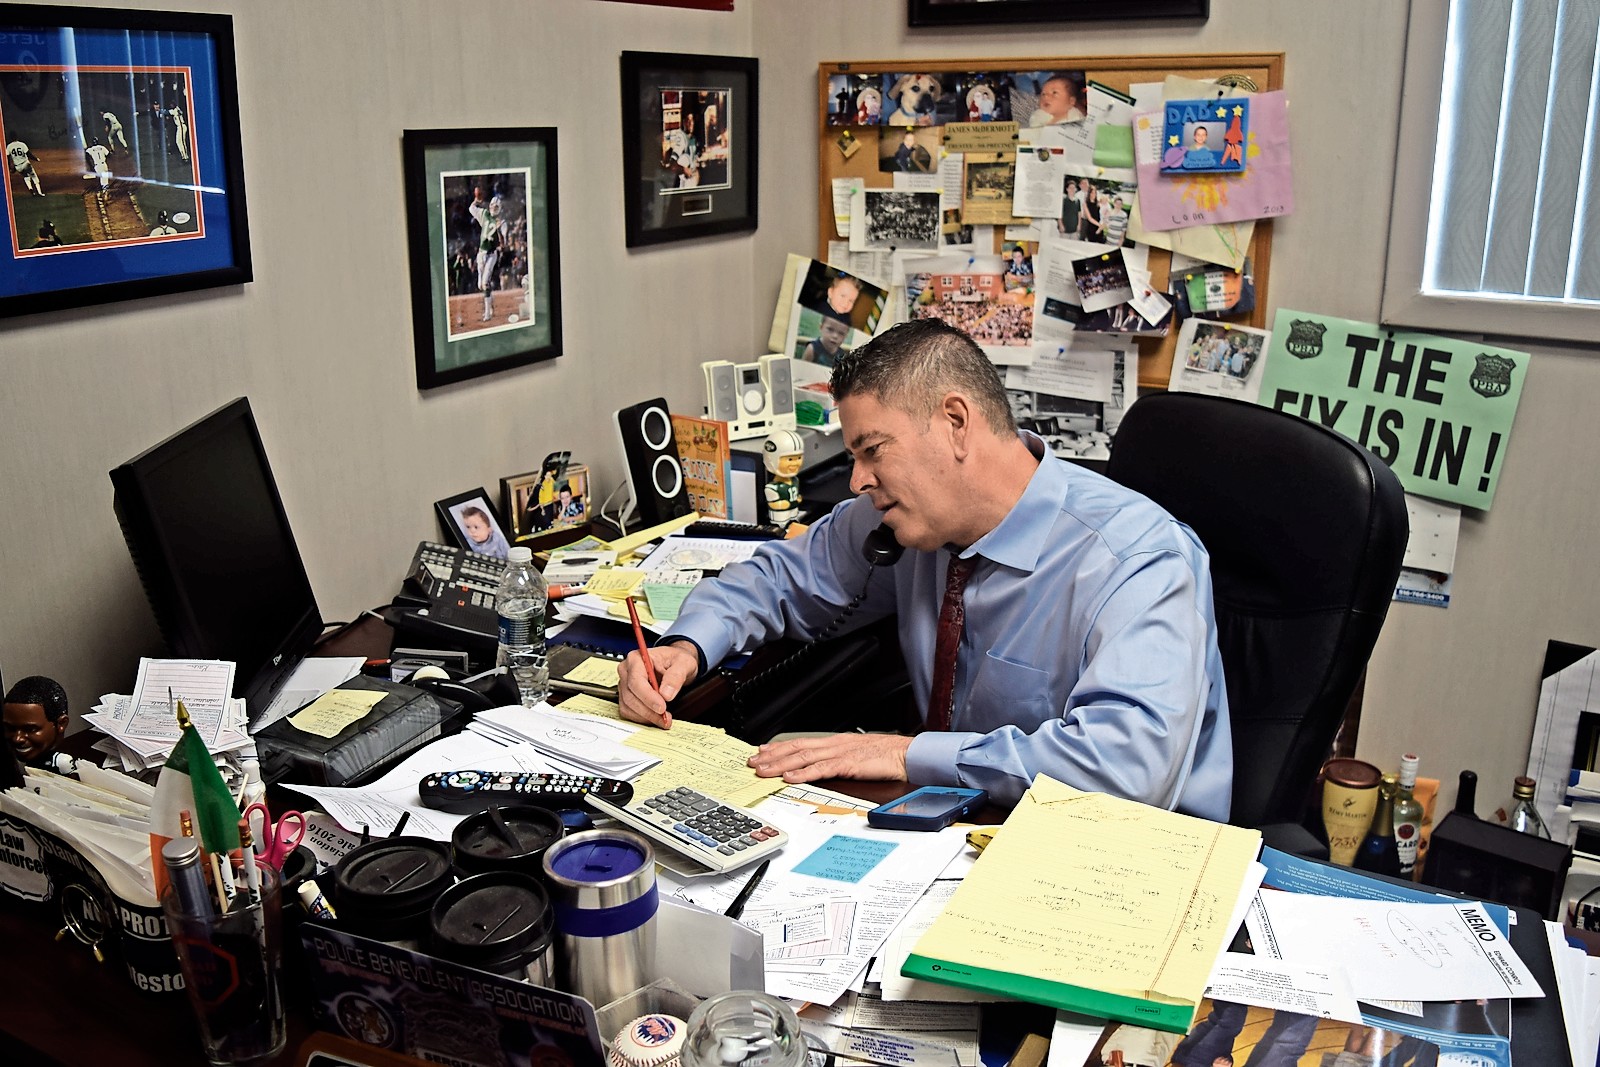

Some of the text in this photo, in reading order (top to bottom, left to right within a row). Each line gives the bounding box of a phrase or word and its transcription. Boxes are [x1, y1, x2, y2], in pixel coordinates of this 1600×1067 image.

[1167, 104, 1211, 125] DAD
[947, 124, 1016, 134] JAMES McDERMOTT
[1291, 343, 1318, 355] PBA
[1345, 333, 1453, 406] THE
[1474, 378, 1504, 393] PBA
[1412, 417, 1472, 486] IN
[788, 487, 798, 502] 12
[1, 826, 26, 851] Law
[307, 822, 336, 843] 2016
[310, 836, 345, 858] ciation
[1460, 907, 1496, 943] MEMO
[1492, 949, 1523, 986] EDWARD CONROY
[314, 938, 368, 968] POLICE
[370, 952, 465, 994] BENEVOLENT
[471, 979, 586, 1025] ASSOCIATION
